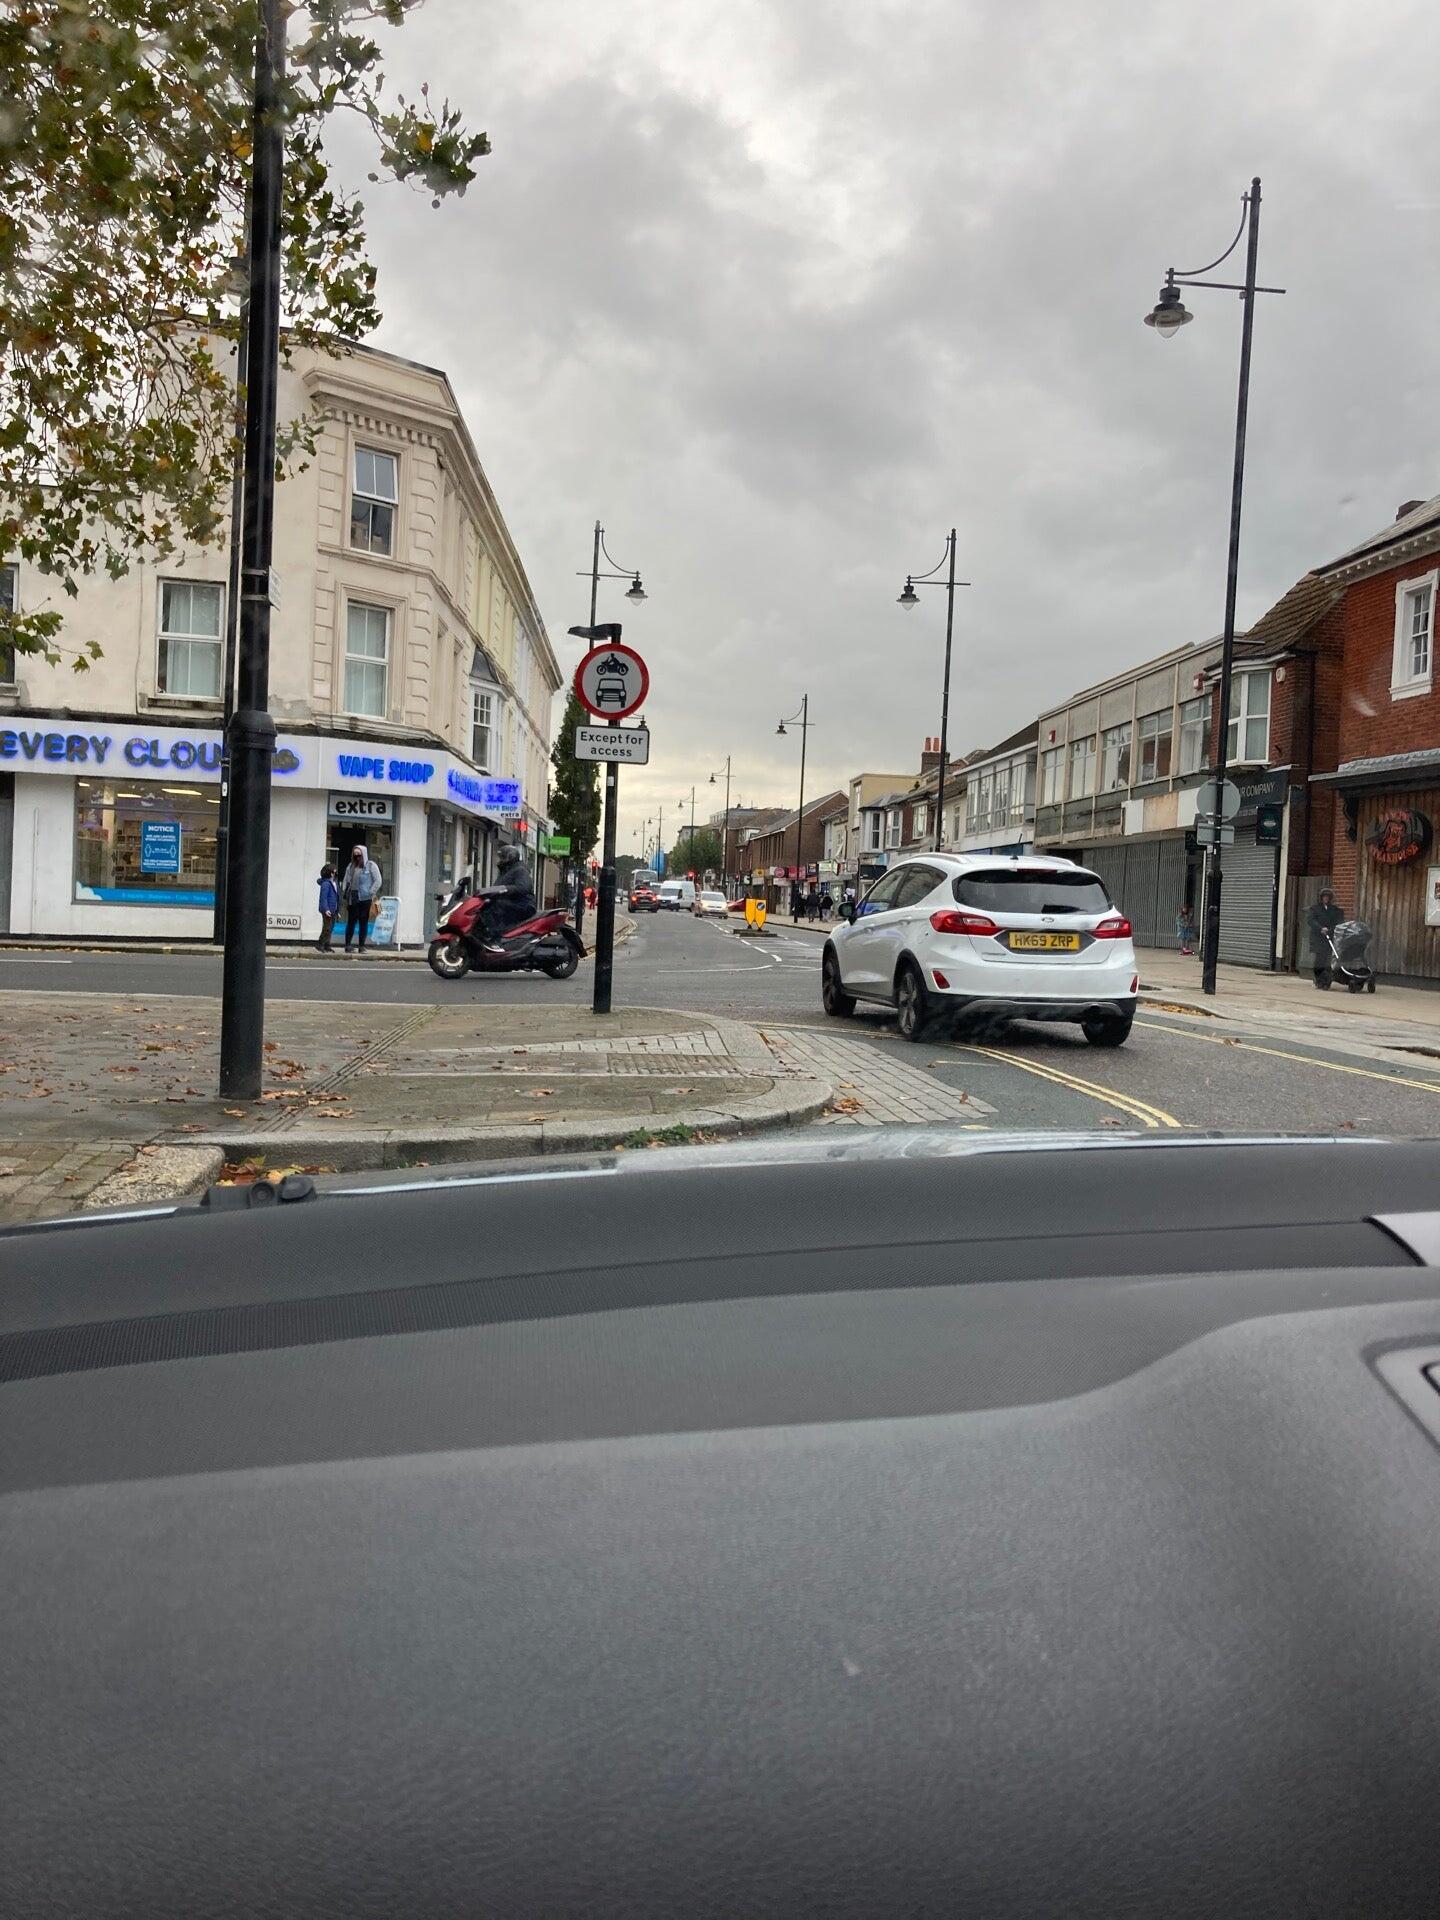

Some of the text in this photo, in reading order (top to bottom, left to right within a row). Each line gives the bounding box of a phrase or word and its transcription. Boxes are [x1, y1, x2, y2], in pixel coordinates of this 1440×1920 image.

[580, 731, 644, 745] Except for
[0, 729, 222, 771] EVERY CLOU
[590, 747, 632, 757] access
[339, 754, 434, 784] VAPE SHOP
[1246, 781, 1276, 797] COMPANY
[335, 799, 387, 815] extra
[148, 825, 175, 833] NOTICE
[276, 917, 298, 926] ROAD
[1014, 934, 1074, 948] HK69 ZRP
